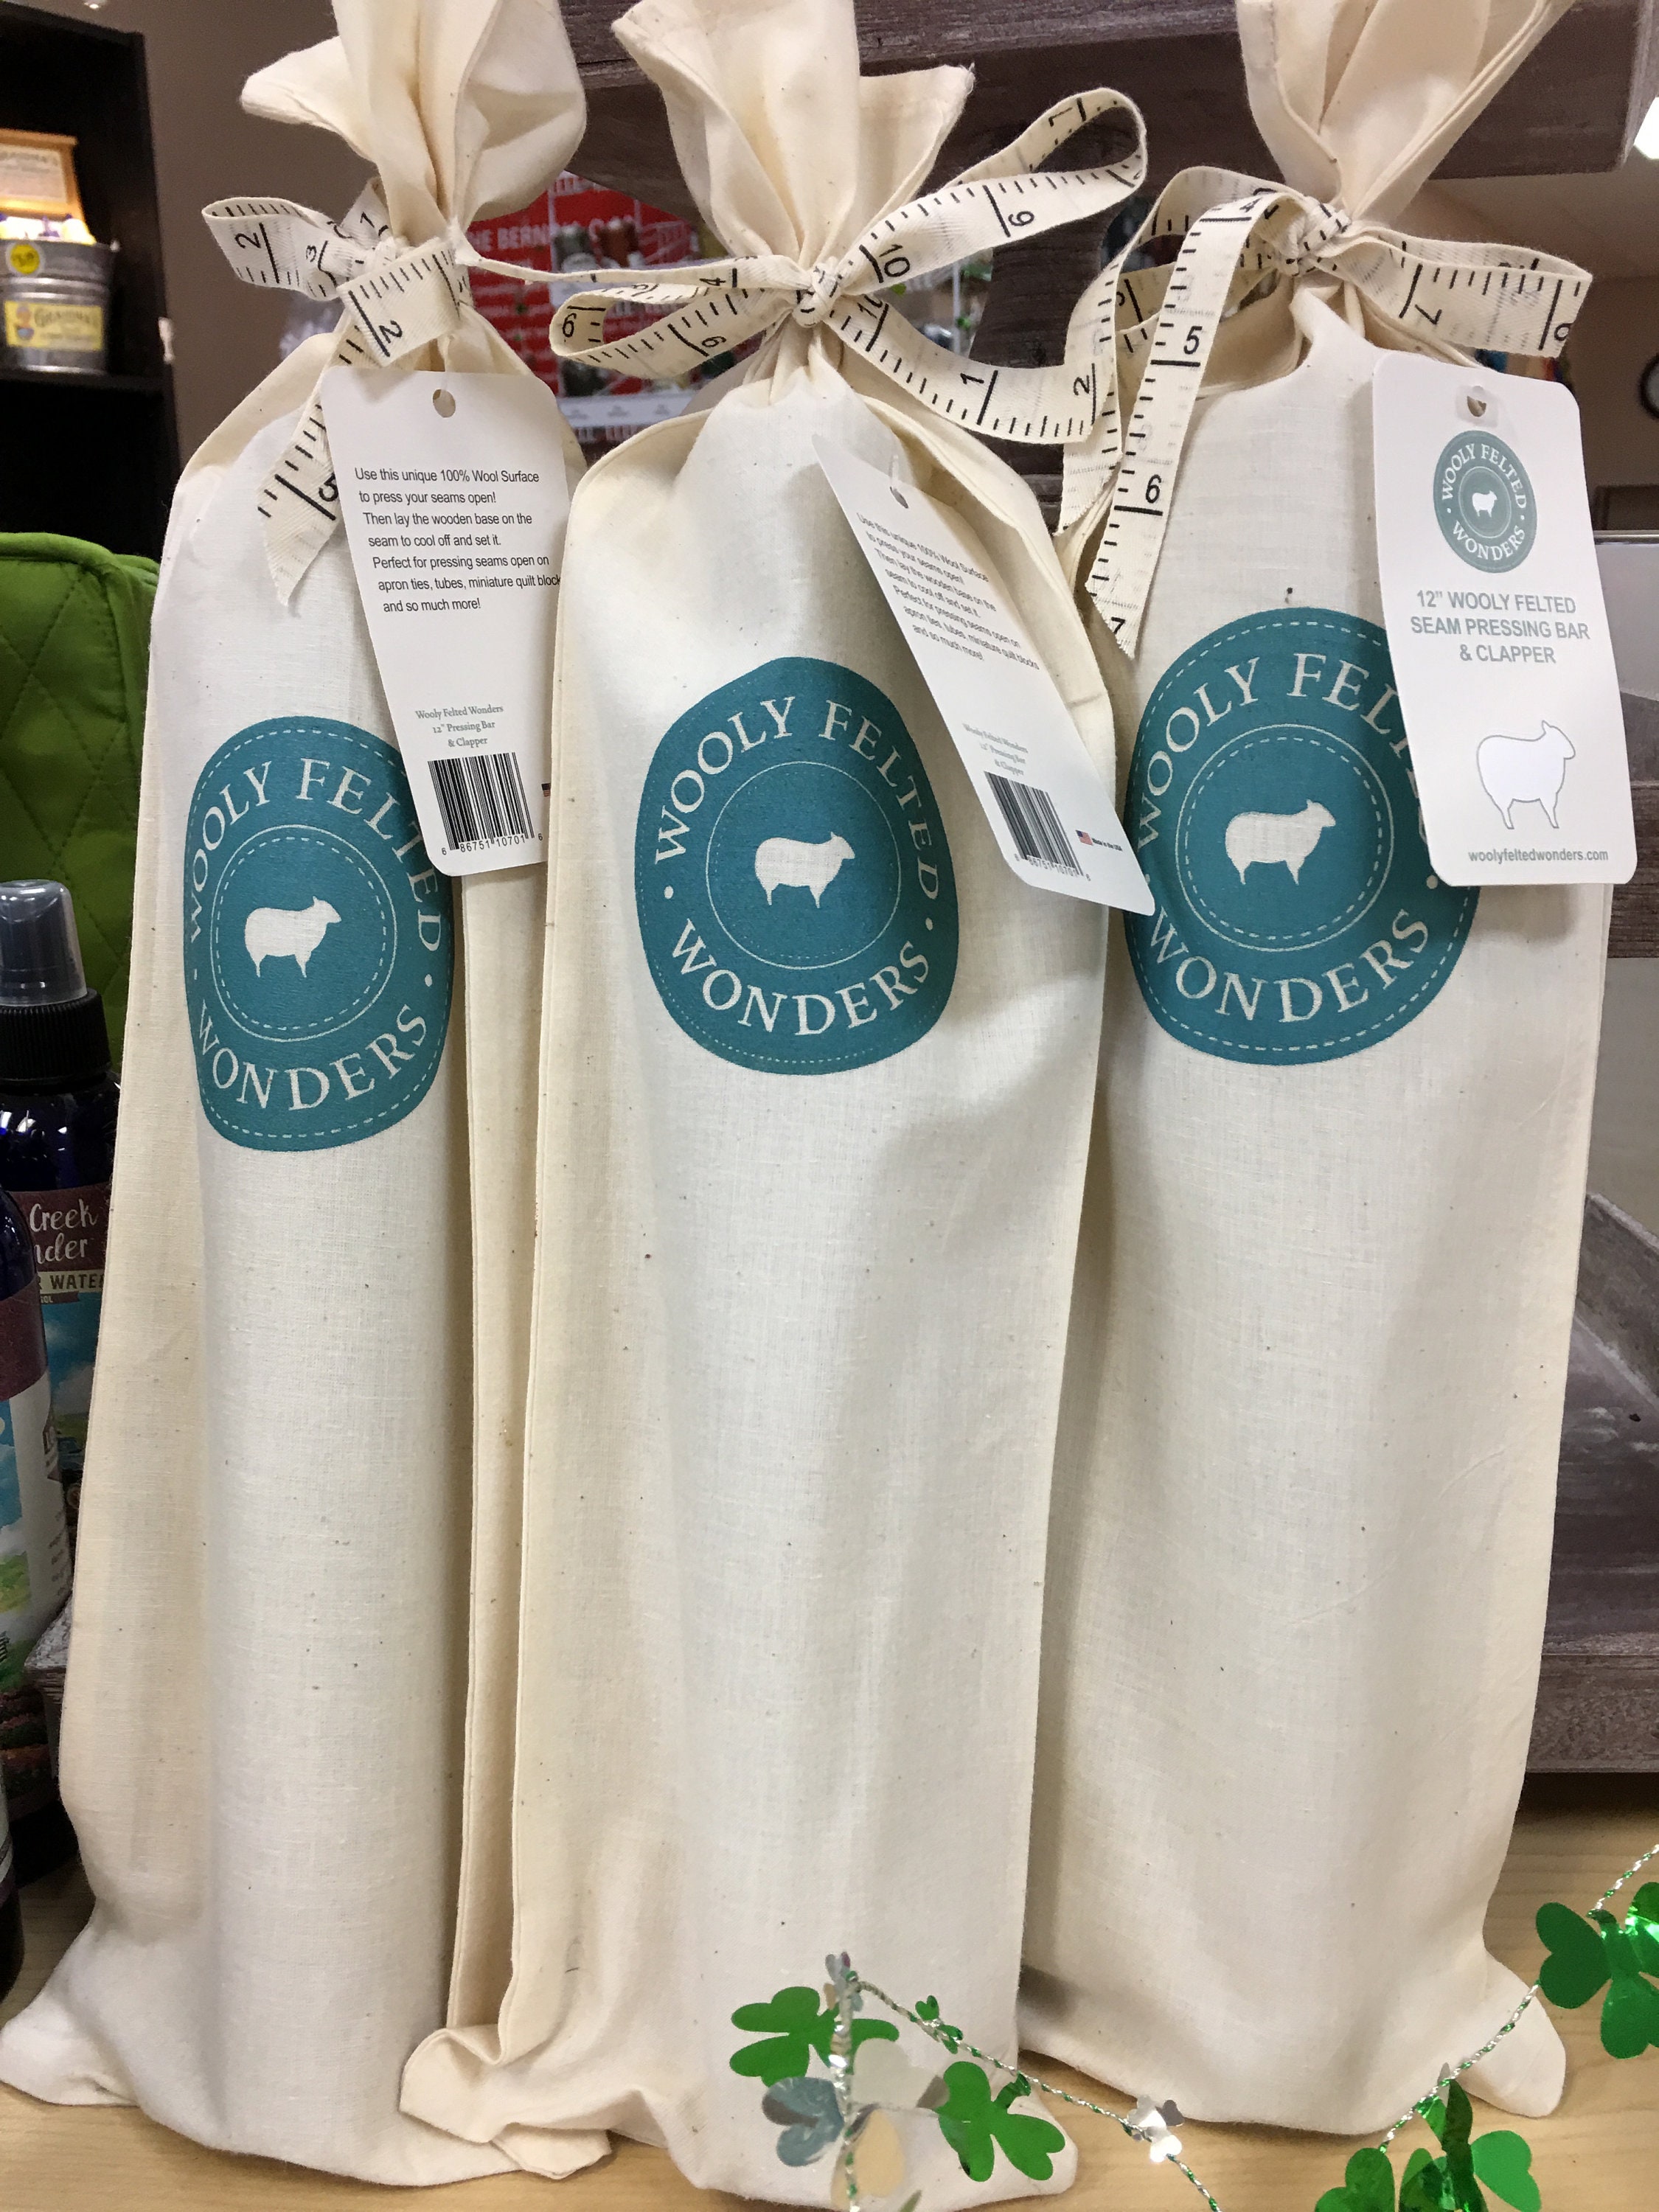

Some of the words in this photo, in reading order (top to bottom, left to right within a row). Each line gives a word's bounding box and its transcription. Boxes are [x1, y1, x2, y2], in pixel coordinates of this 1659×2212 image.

[234, 231, 262, 249] 2
[378, 319, 404, 344] 2
[1183, 325, 1203, 355] 5
[1073, 375, 1091, 395] 2
[354, 467, 378, 481] Use
[379, 467, 400, 481] this
[401, 469, 438, 484] unique
[440, 469, 470, 482] 100%
[471, 470, 499, 482] Wool
[501, 470, 540, 483] Surface
[1441, 442, 1475, 501] WOOLY
[1481, 444, 1527, 509] FELTED
[358, 490, 370, 503] to
[372, 493, 403, 505] press
[404, 493, 428, 506] your
[431, 493, 466, 504] seams
[467, 491, 497, 506] open!
[1144, 473, 1163, 504] 6
[362, 512, 392, 525] Then
[394, 512, 410, 528] lay
[411, 512, 430, 525] the
[431, 512, 473, 525] wooden
[474, 512, 500, 525] base
[501, 515, 515, 525] on
[516, 512, 532, 524] the
[368, 537, 399, 547] seam
[400, 535, 411, 547] to
[414, 534, 436, 546] cool
[437, 534, 451, 546] off
[453, 534, 473, 546] and
[474, 535, 491, 546] set
[492, 534, 501, 546] it.
[1452, 520, 1525, 561] WONDERS
[372, 556, 412, 569] Perfect
[412, 556, 428, 568] for
[429, 555, 473, 571] pressing
[475, 557, 509, 567] seams
[510, 557, 535, 568] open
[537, 556, 550, 566] on
[378, 580, 409, 594] apron
[410, 577, 434, 591] ties,
[434, 577, 467, 590] tubes,
[467, 576, 514, 588] miniature
[515, 574, 537, 588] quilt
[383, 599, 404, 613] and
[406, 602, 419, 612] so
[420, 598, 450, 611] much
[451, 597, 481, 610] more!
[1447, 591, 1510, 611] WOOLY
[1514, 594, 1576, 614] FELTED
[1411, 616, 1461, 635] SEAM
[1466, 618, 1553, 639] PRESSING
[1556, 622, 1591, 640] BAR
[1459, 644, 1472, 662] &
[1475, 644, 1557, 664] CLAPPER
[415, 709, 442, 720] Wooly
[443, 707, 468, 717] Felted
[468, 704, 504, 714] Wonders
[447, 721, 481, 732] Pressing
[481, 720, 495, 728] Bar
[448, 739, 455, 748] &
[456, 737, 488, 748] Clapper
[1136, 656, 1261, 850] WOOLY
[655, 695, 796, 865] WOOLY
[818, 699, 941, 901] FELTED
[459, 841, 490, 852] 86751
[495, 835, 526, 846] 10701
[538, 833, 543, 841] 6
[296, 757, 444, 952] FELTED
[1468, 849, 1608, 864] woolyfeltedwonders.com
[1149, 905, 1430, 1024] WONDERS
[672, 917, 931, 1036] WONDERS
[198, 1004, 428, 1112] WONDERS
[29, 1198, 99, 1232] Creek
